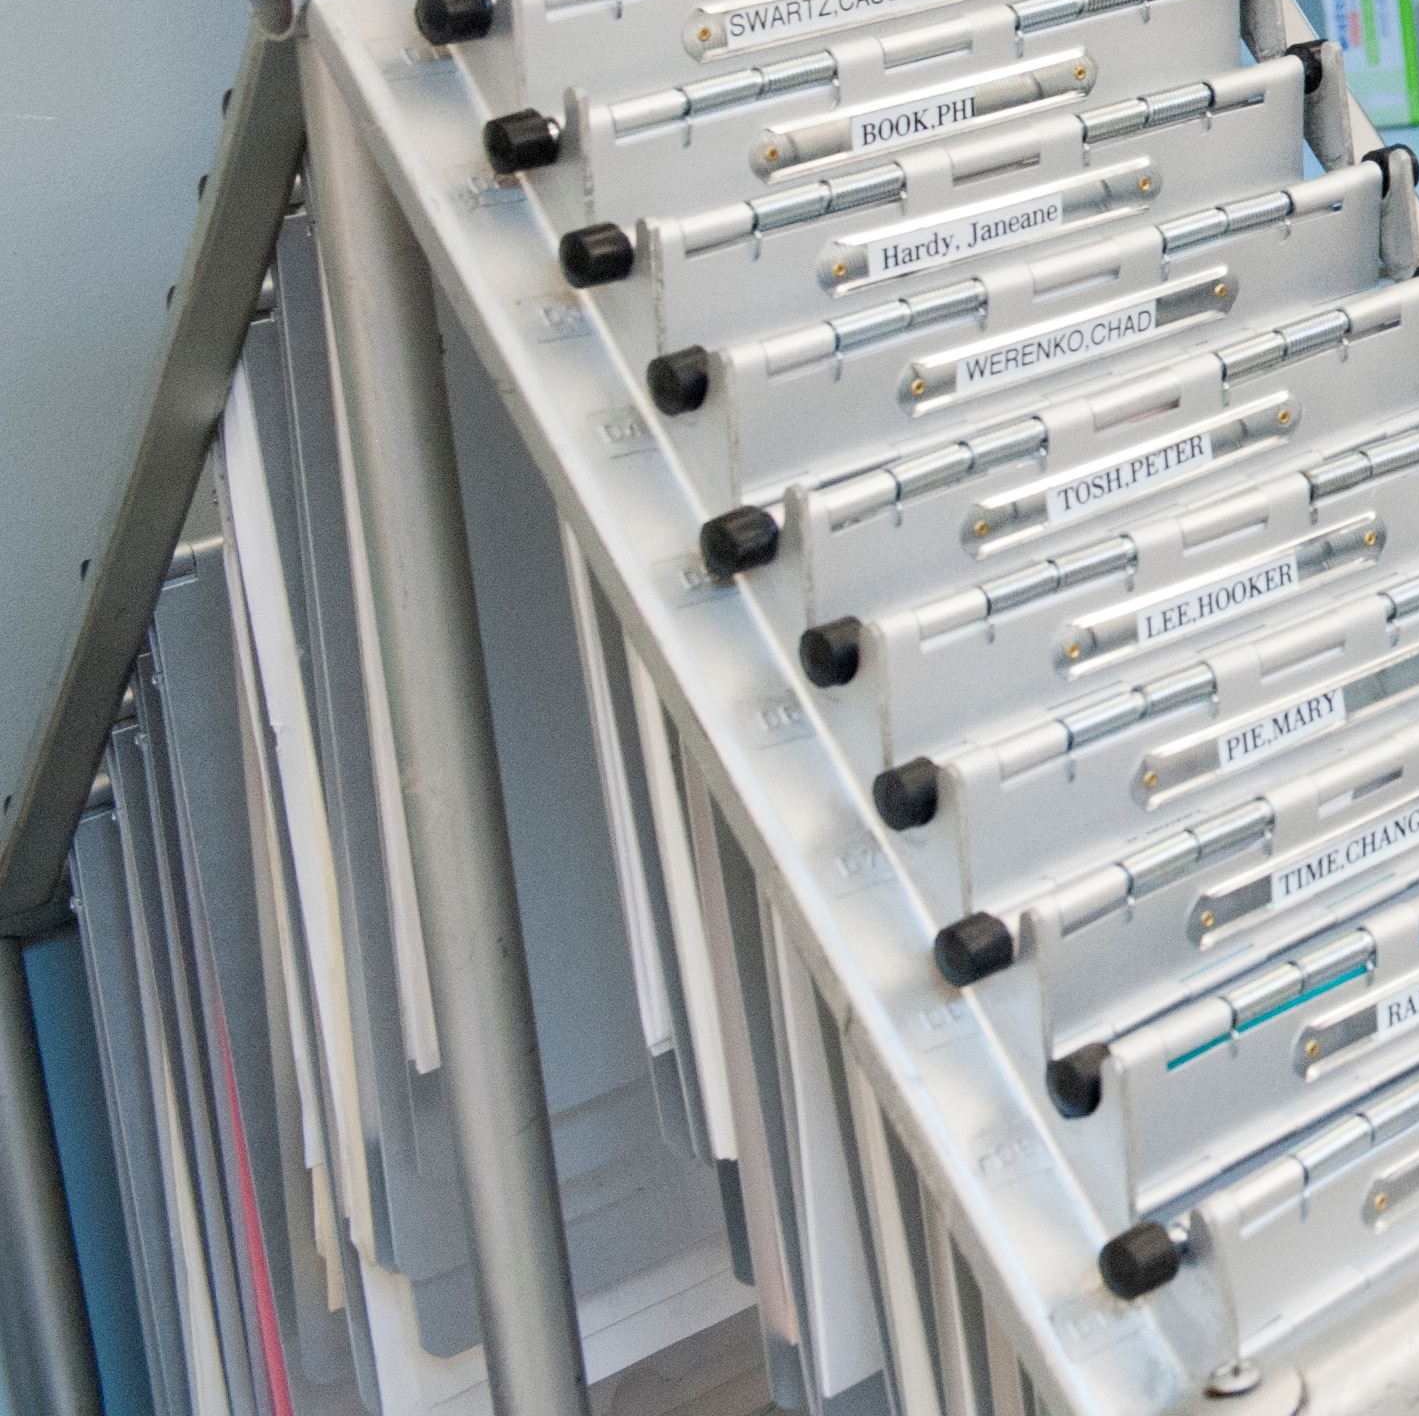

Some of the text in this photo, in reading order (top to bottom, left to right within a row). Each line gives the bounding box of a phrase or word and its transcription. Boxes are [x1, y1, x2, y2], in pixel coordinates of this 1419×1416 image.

[882, 204, 1059, 270] Hardy, Janeane
[966, 310, 1153, 382] WERENKO,CHAD
